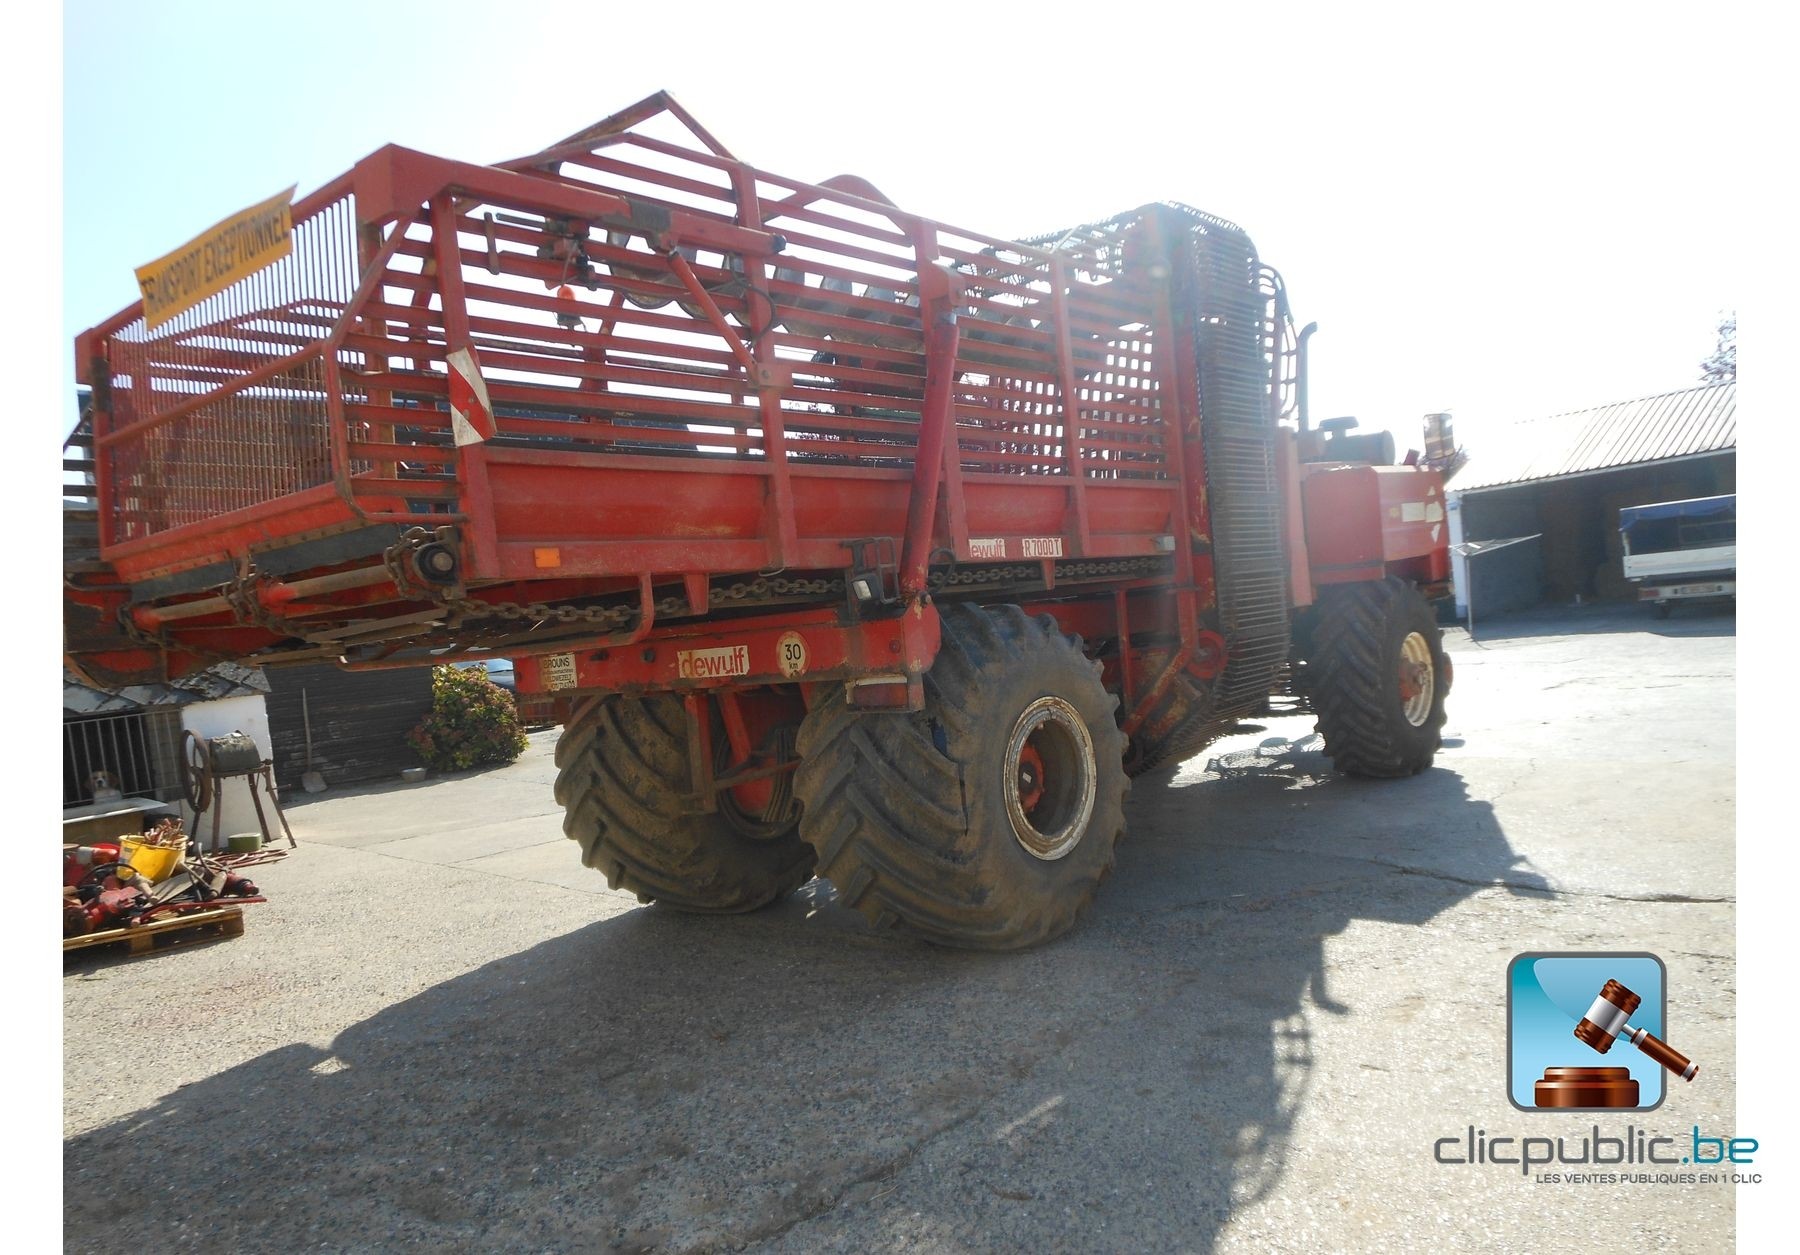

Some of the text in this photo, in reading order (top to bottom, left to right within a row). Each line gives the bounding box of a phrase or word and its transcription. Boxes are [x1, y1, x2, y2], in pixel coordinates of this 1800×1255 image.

[203, 209, 290, 284] EXCEPTIONNEL
[970, 539, 1003, 557] ewulf
[785, 643, 801, 660] 30
[543, 656, 570, 669] BROUNS
[682, 647, 744, 677] dewulf
[789, 661, 799, 670] km
